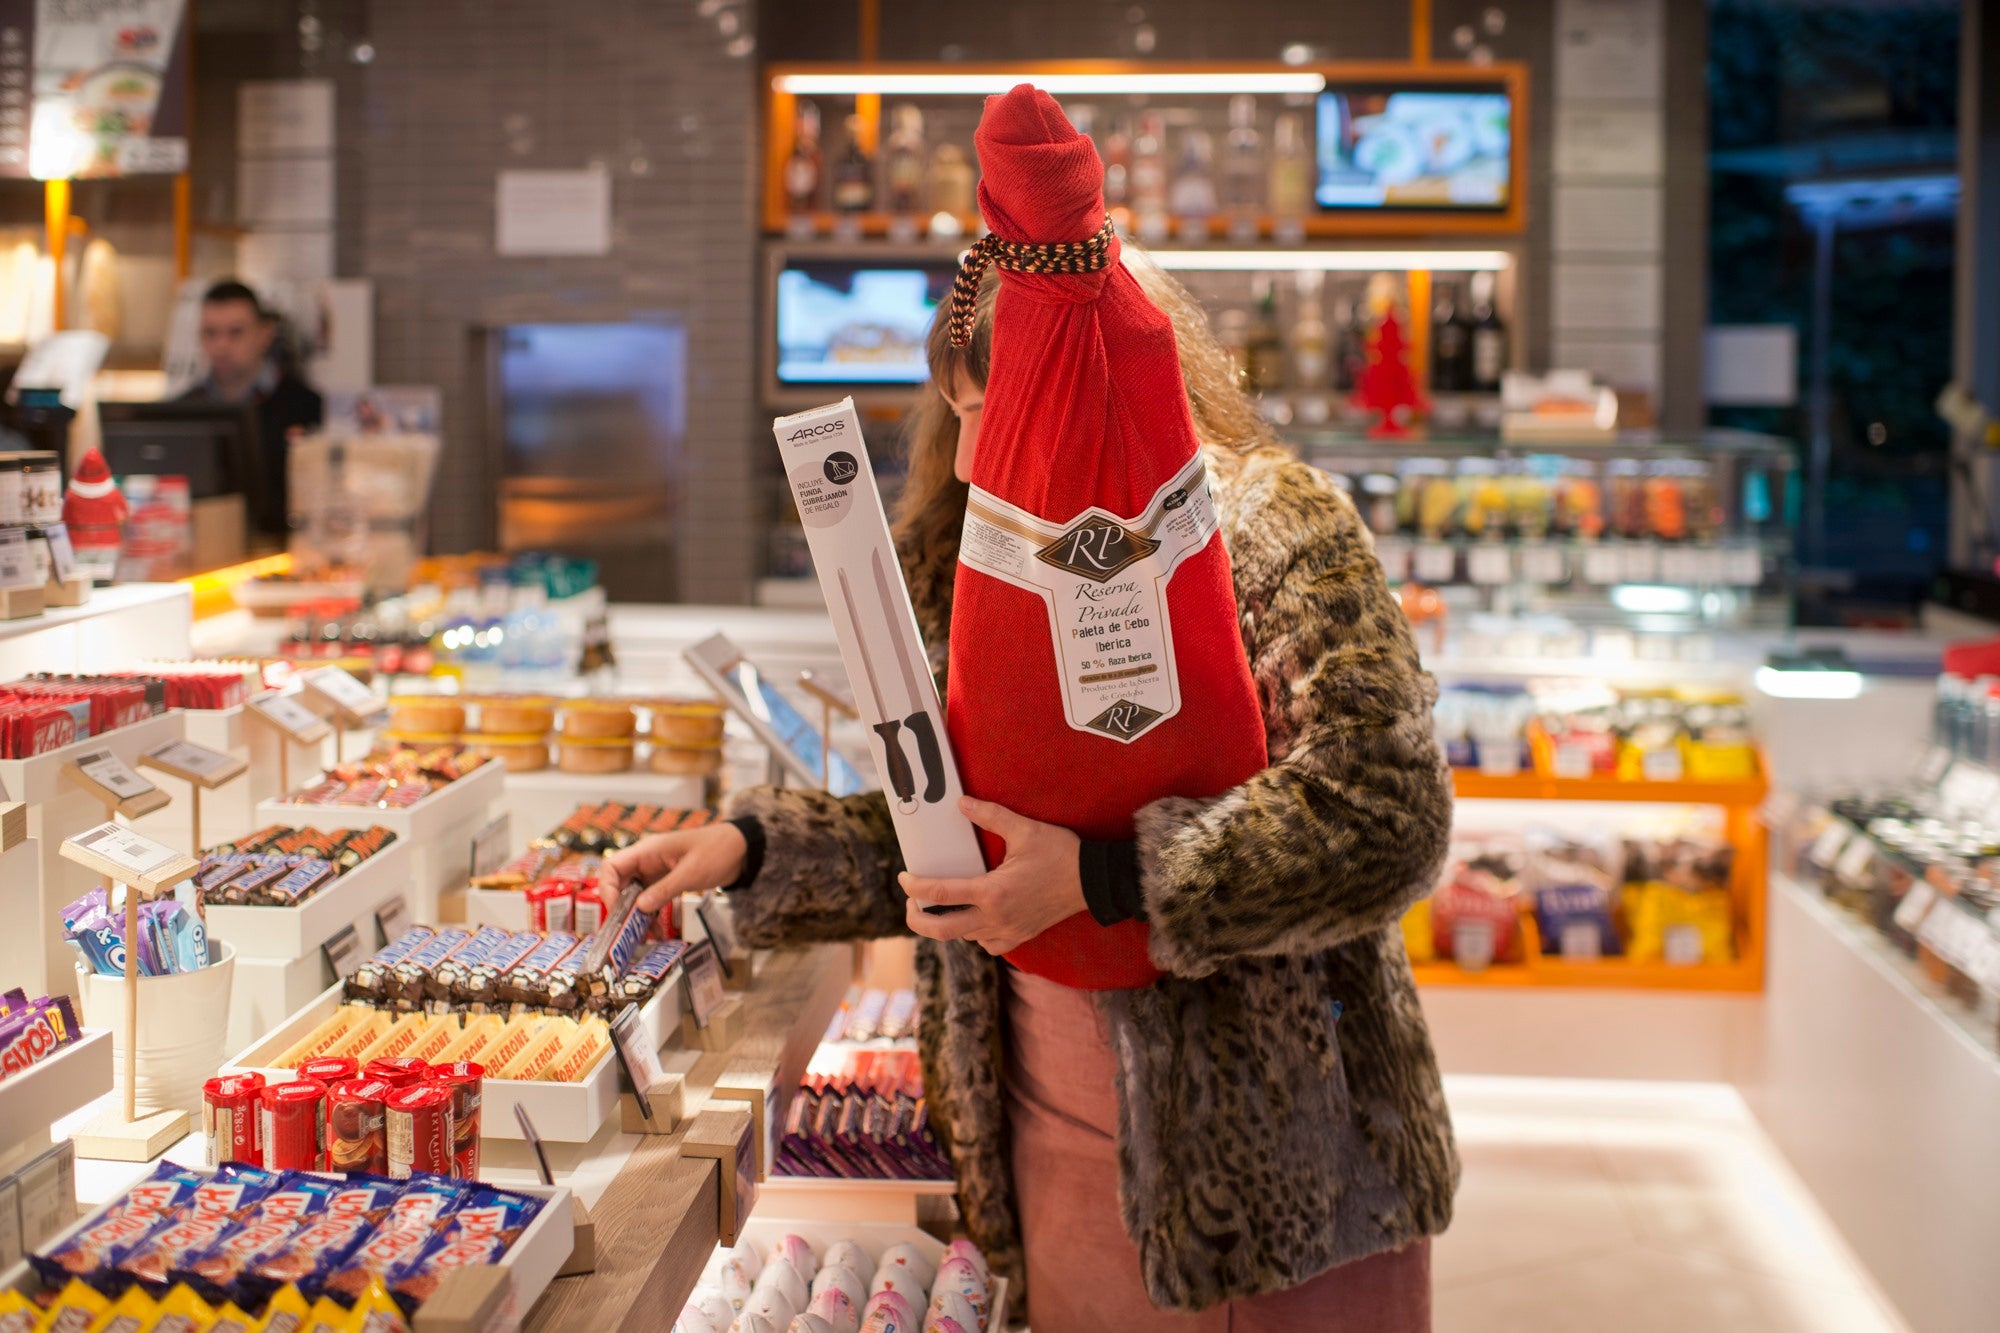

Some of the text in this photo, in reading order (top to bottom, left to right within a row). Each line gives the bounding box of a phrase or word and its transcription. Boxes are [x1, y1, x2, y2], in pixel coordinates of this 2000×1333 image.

[787, 421, 845, 442] ARCOS
[797, 478, 824, 490] INCLUYE
[800, 487, 822, 498] FUNDA
[802, 489, 848, 507] CUBREJAMÓN
[804, 500, 840, 515] DE REGALO
[1067, 525, 1125, 569] RP
[1075, 581, 1139, 602] Reserva
[1078, 590, 1144, 623] Privada
[1072, 618, 1150, 639] Paleta de Cebo
[1081, 661, 1091, 670] 50
[1093, 659, 1105, 669] %
[1108, 656, 1126, 666] Raza
[1081, 683, 1116, 694] Producto
[1106, 704, 1140, 733] RP
[193, 925, 208, 969] REO
